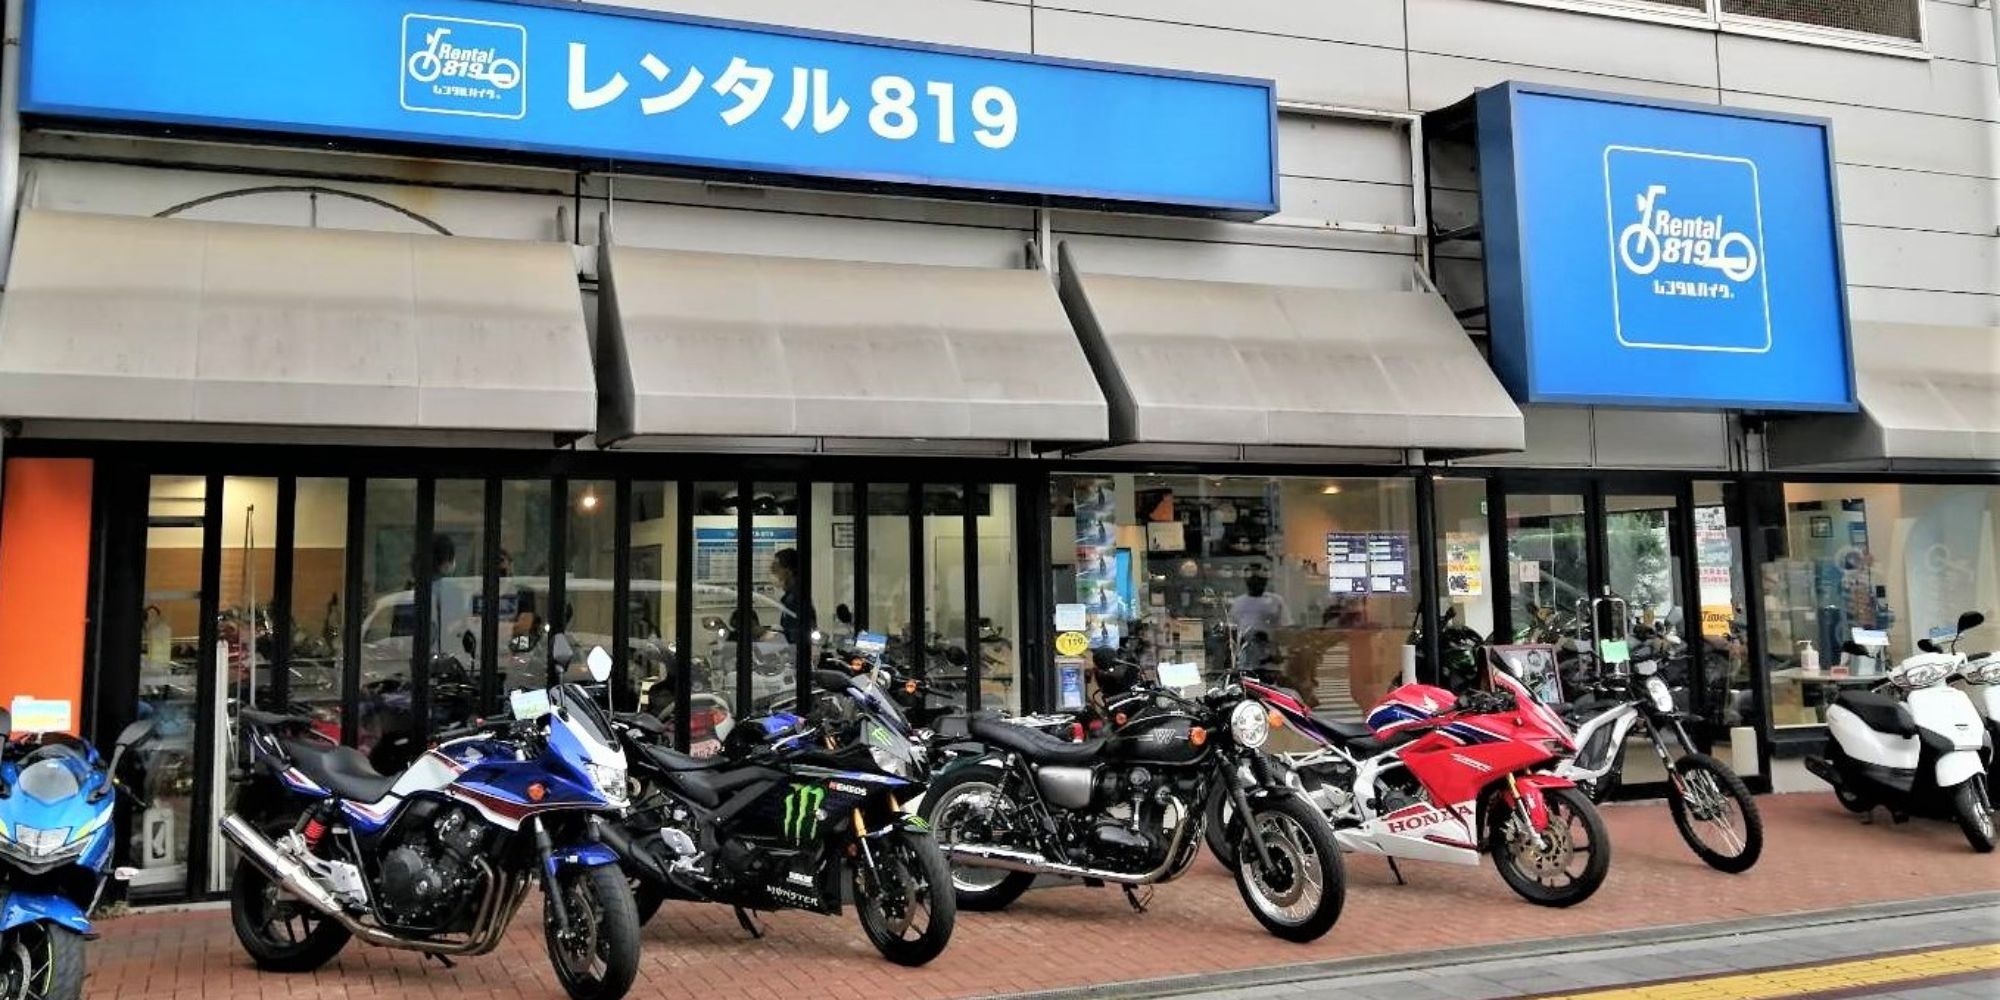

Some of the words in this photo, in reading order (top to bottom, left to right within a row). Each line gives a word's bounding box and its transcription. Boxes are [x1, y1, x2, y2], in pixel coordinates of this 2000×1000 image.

[439, 42, 495, 64] Rental
[442, 60, 483, 79] 819
[1655, 210, 1722, 241] Rental
[1662, 237, 1712, 267] 819
